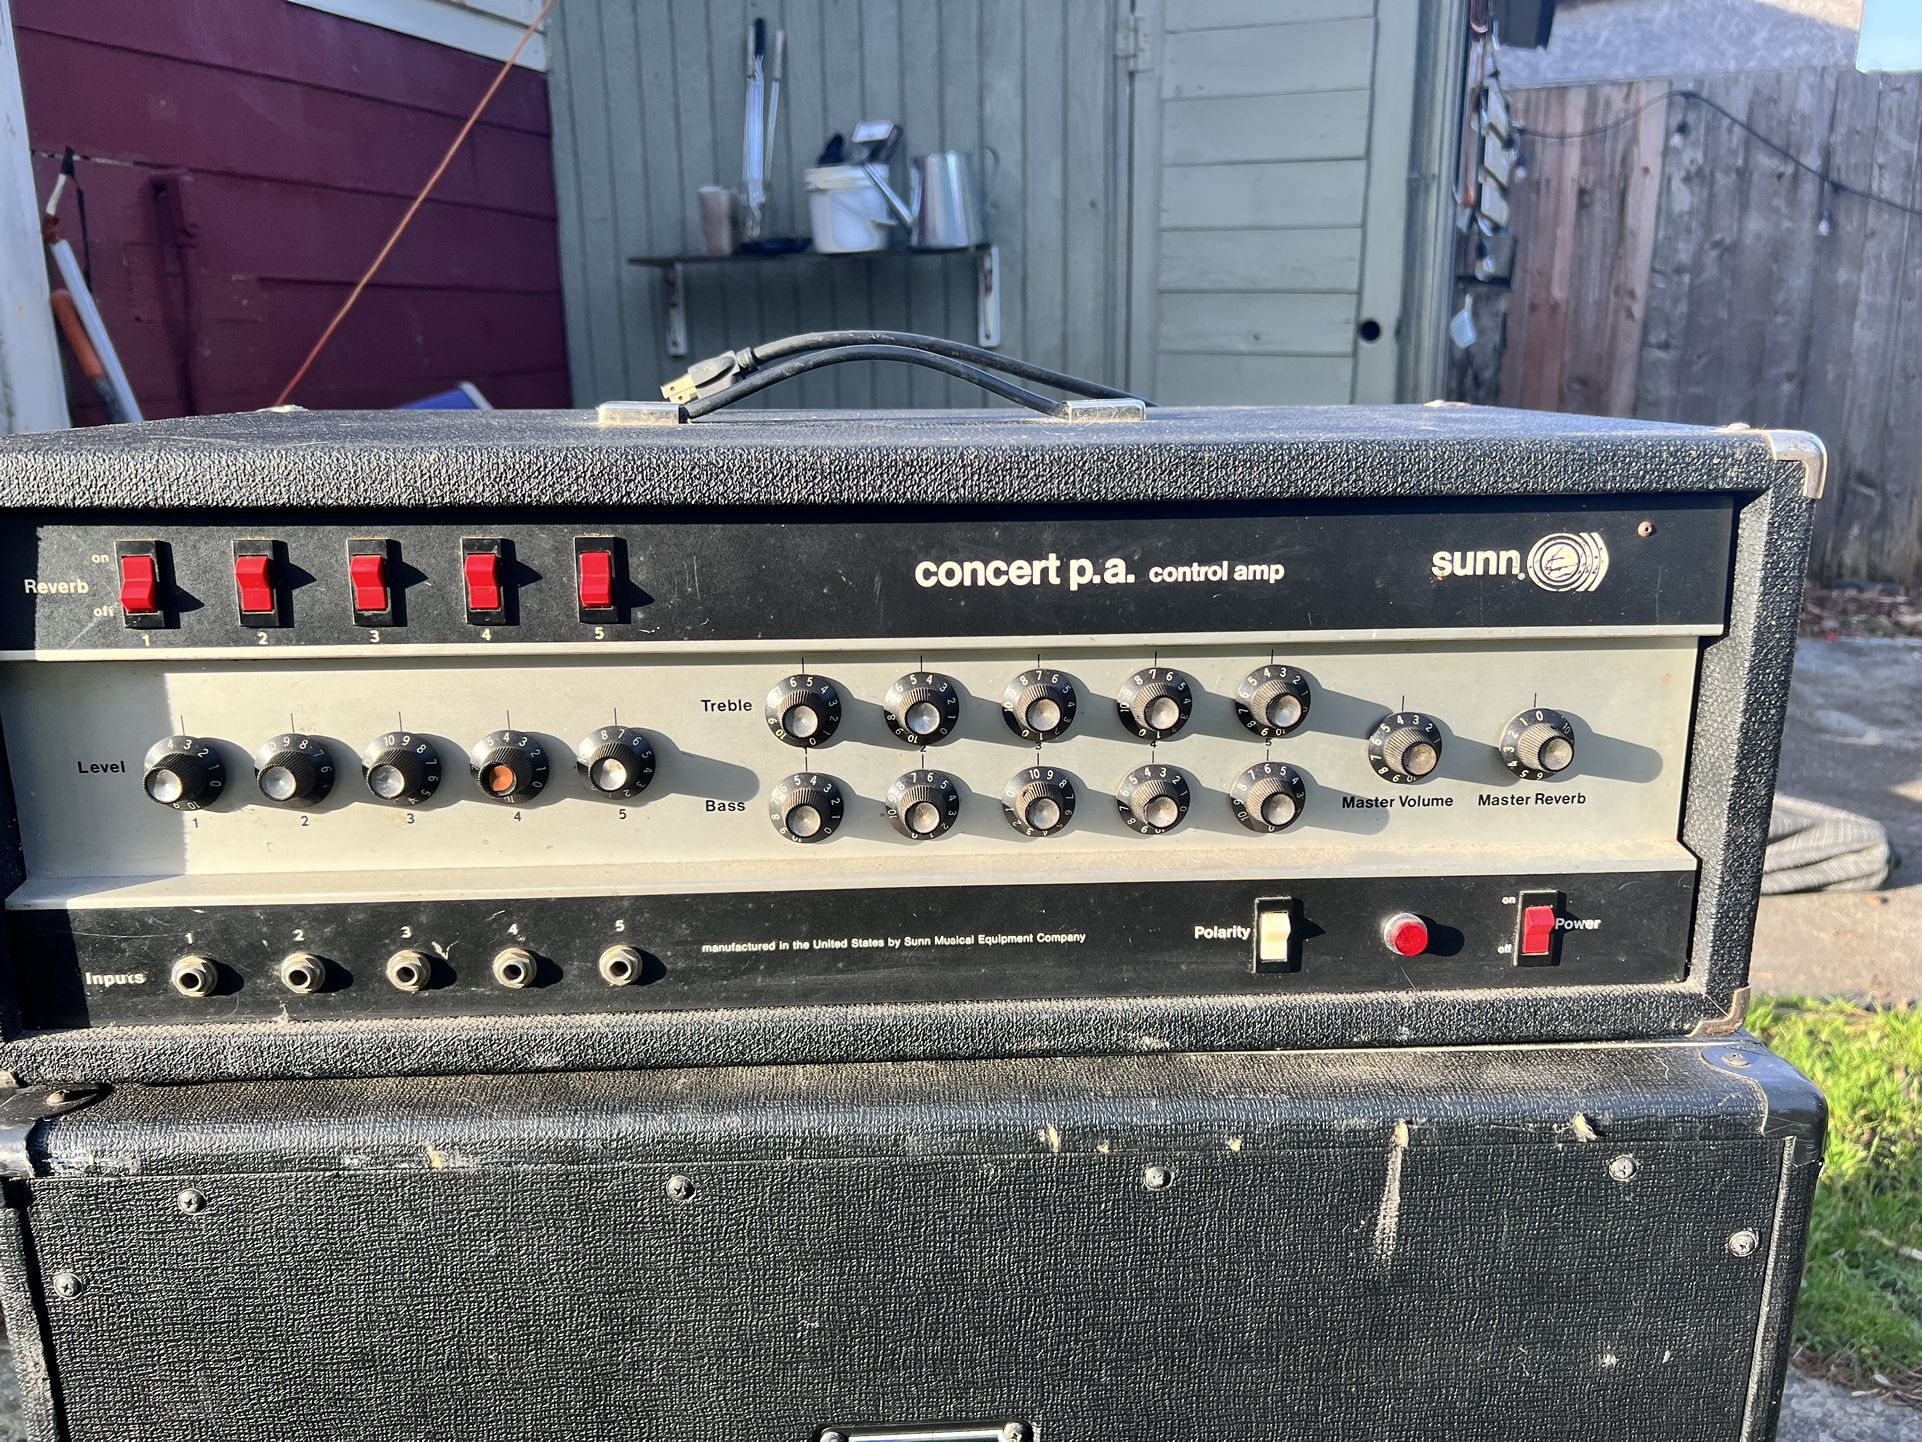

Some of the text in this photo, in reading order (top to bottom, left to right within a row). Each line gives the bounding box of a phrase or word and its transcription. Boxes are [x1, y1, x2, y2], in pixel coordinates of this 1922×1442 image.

[91, 553, 110, 564] on
[915, 553, 1285, 591] concert p.a. control amp
[24, 578, 89, 594] Reverb
[93, 605, 114, 617] off
[257, 631, 268, 645] 2
[370, 630, 380, 643] 3
[481, 628, 491, 641] 4
[594, 626, 604, 640] 5
[142, 633, 150, 646] 1
[1035, 670, 1043, 681] 7
[1166, 671, 1174, 681] 6
[1263, 668, 1271, 678] 4
[789, 676, 797, 687] 6
[805, 676, 813, 687] 5
[910, 674, 919, 685] 5
[926, 674, 934, 685] 4
[1051, 674, 1060, 684] 6
[700, 699, 753, 712] Treble
[1396, 715, 1404, 725] 4
[1535, 710, 1544, 722] 0
[183, 739, 192, 750] 3
[300, 739, 309, 749] 8
[401, 735, 410, 746] 9
[518, 736, 528, 747] 3
[1035, 741, 1042, 750] 3
[1150, 740, 1157, 748] 4
[1265, 738, 1272, 746] 5
[919, 744, 927, 752] 2
[77, 760, 126, 774] Level
[1160, 767, 1168, 778] 3
[1279, 765, 1287, 776] 5
[1029, 769, 1040, 780] 10
[1046, 770, 1054, 780] 9
[1342, 795, 1454, 809] Master Volume
[1478, 792, 1586, 806] Master Reverb
[705, 799, 746, 812] Bass
[406, 813, 415, 824] 3
[513, 810, 521, 821] 4
[619, 808, 627, 820] 5
[192, 817, 199, 829] 1
[300, 815, 309, 826] 2
[1501, 896, 1517, 905] on
[507, 923, 519, 935] 4
[615, 919, 625, 932] 5
[1554, 917, 1602, 930] Power
[184, 931, 193, 944] 1
[292, 928, 305, 941] 2
[400, 925, 412, 939] 3
[1194, 924, 1251, 941] Polarity
[701, 932, 1086, 952] manufactured in the United States by Sunn Musical Equipment Company
[1497, 943, 1513, 954] off
[85, 971, 147, 988] Inputs
